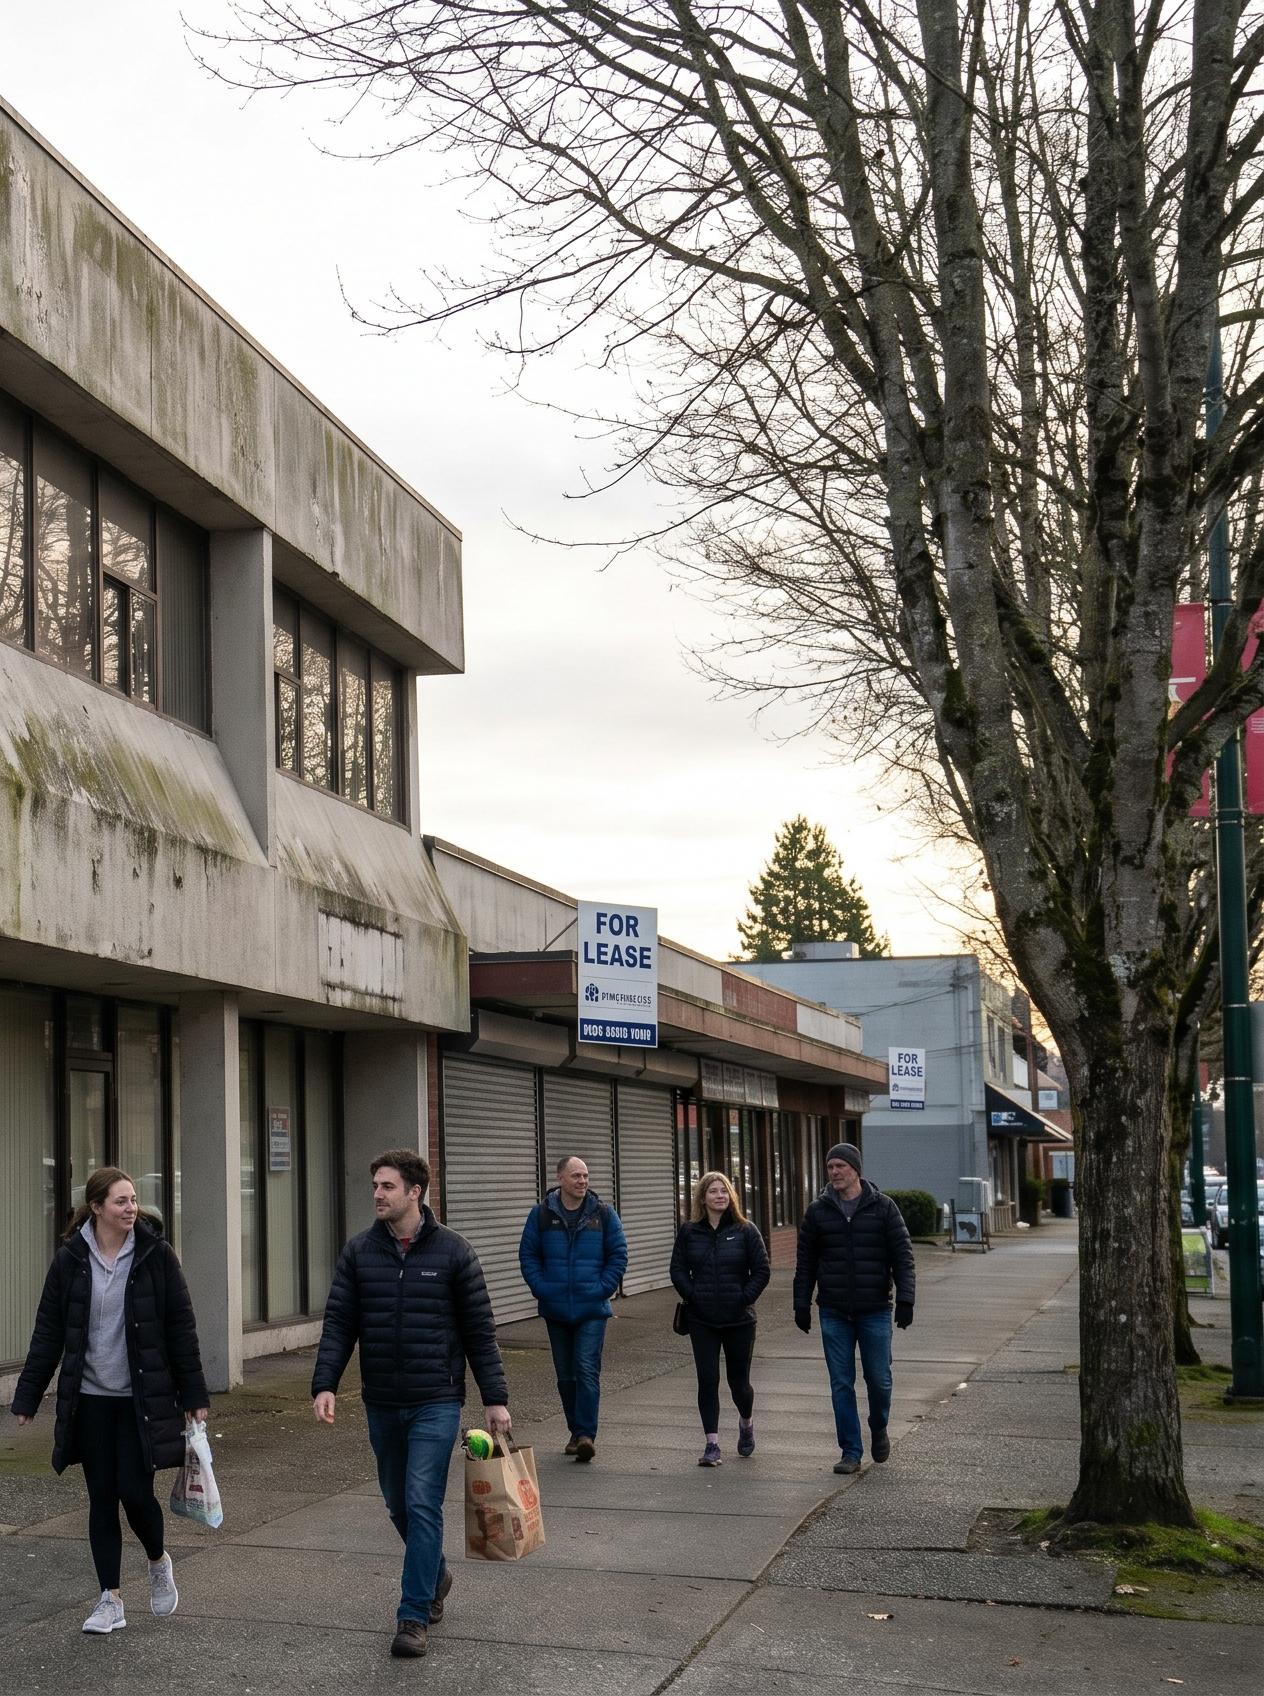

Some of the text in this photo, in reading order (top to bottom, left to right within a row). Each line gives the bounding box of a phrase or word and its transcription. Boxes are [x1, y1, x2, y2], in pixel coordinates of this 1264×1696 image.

[596, 912, 639, 938] FOR
[584, 941, 651, 969] LEASE
[898, 1053, 918, 1064] FOR
[891, 1065, 923, 1077] LEASE
